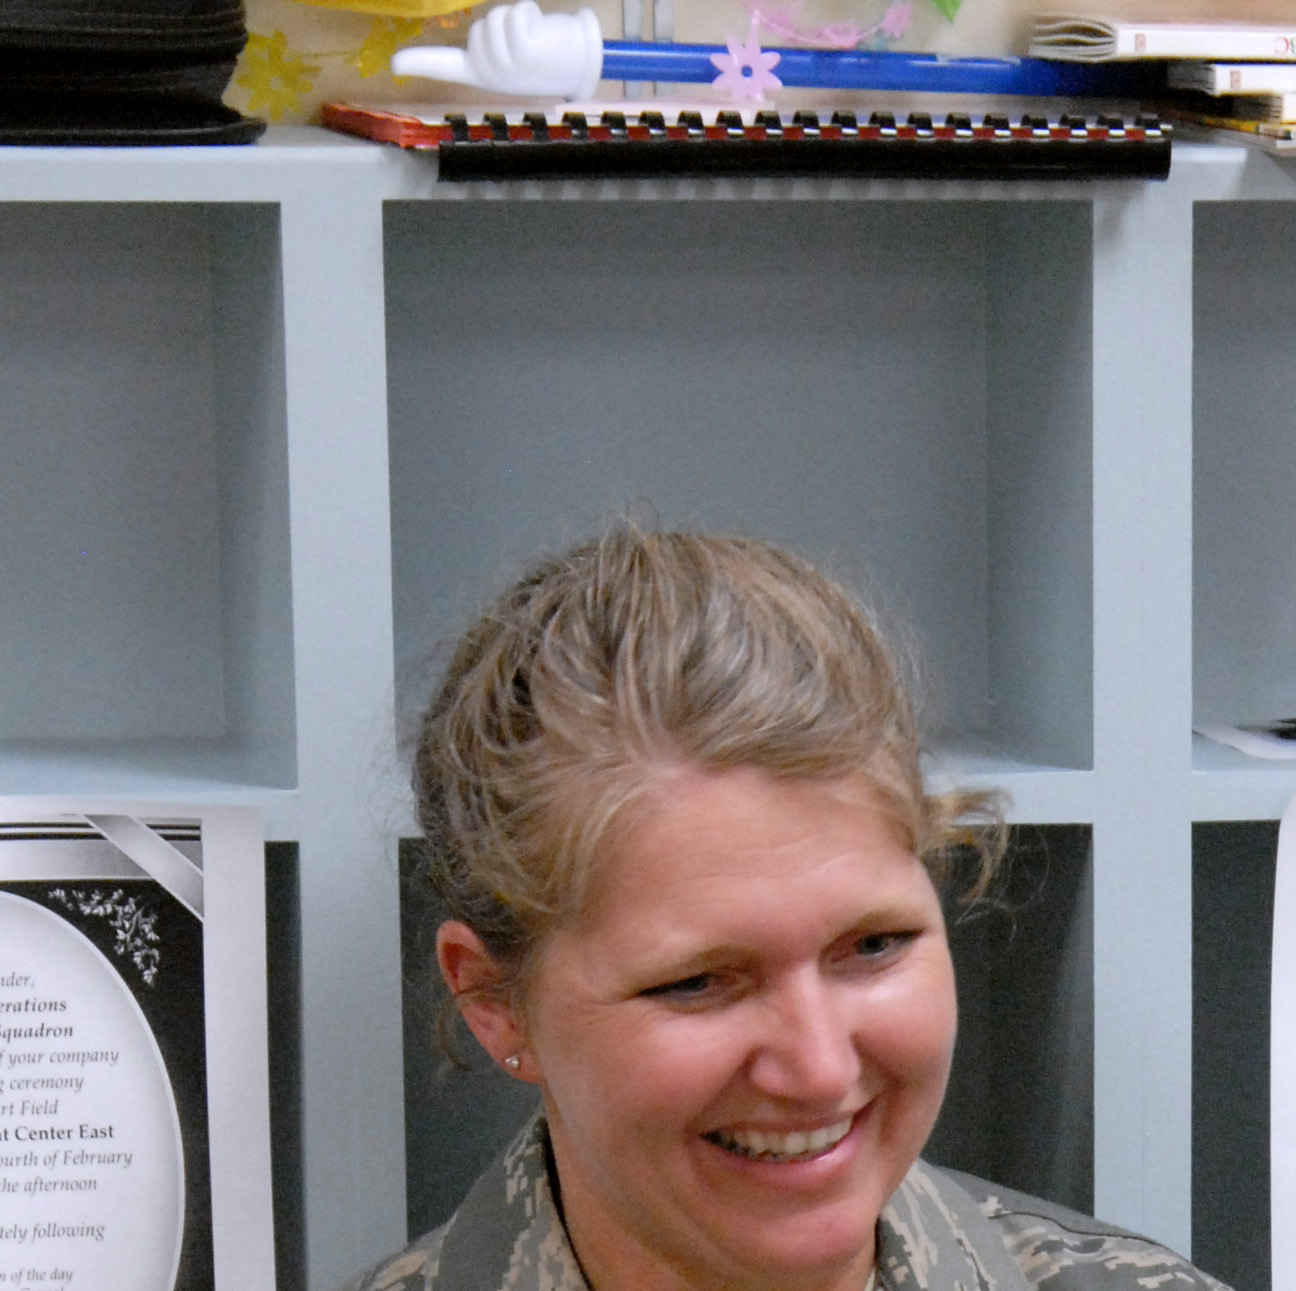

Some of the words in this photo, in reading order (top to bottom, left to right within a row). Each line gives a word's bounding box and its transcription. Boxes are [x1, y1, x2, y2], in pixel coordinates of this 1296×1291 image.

[0, 1021, 74, 1043] quadron
[8, 1051, 46, 1069] your
[48, 1049, 120, 1068] company
[9, 1076, 85, 1093] ceremony
[20, 1098, 60, 1117] Field
[14, 1125, 74, 1141] Center
[79, 1123, 115, 1140] East
[43, 1150, 60, 1171] of
[62, 1148, 134, 1169] February
[24, 1176, 98, 1198] afternoon
[31, 1221, 106, 1243] following
[10, 1267, 24, 1286] of
[27, 1267, 47, 1281] the
[49, 1267, 74, 1285] day
